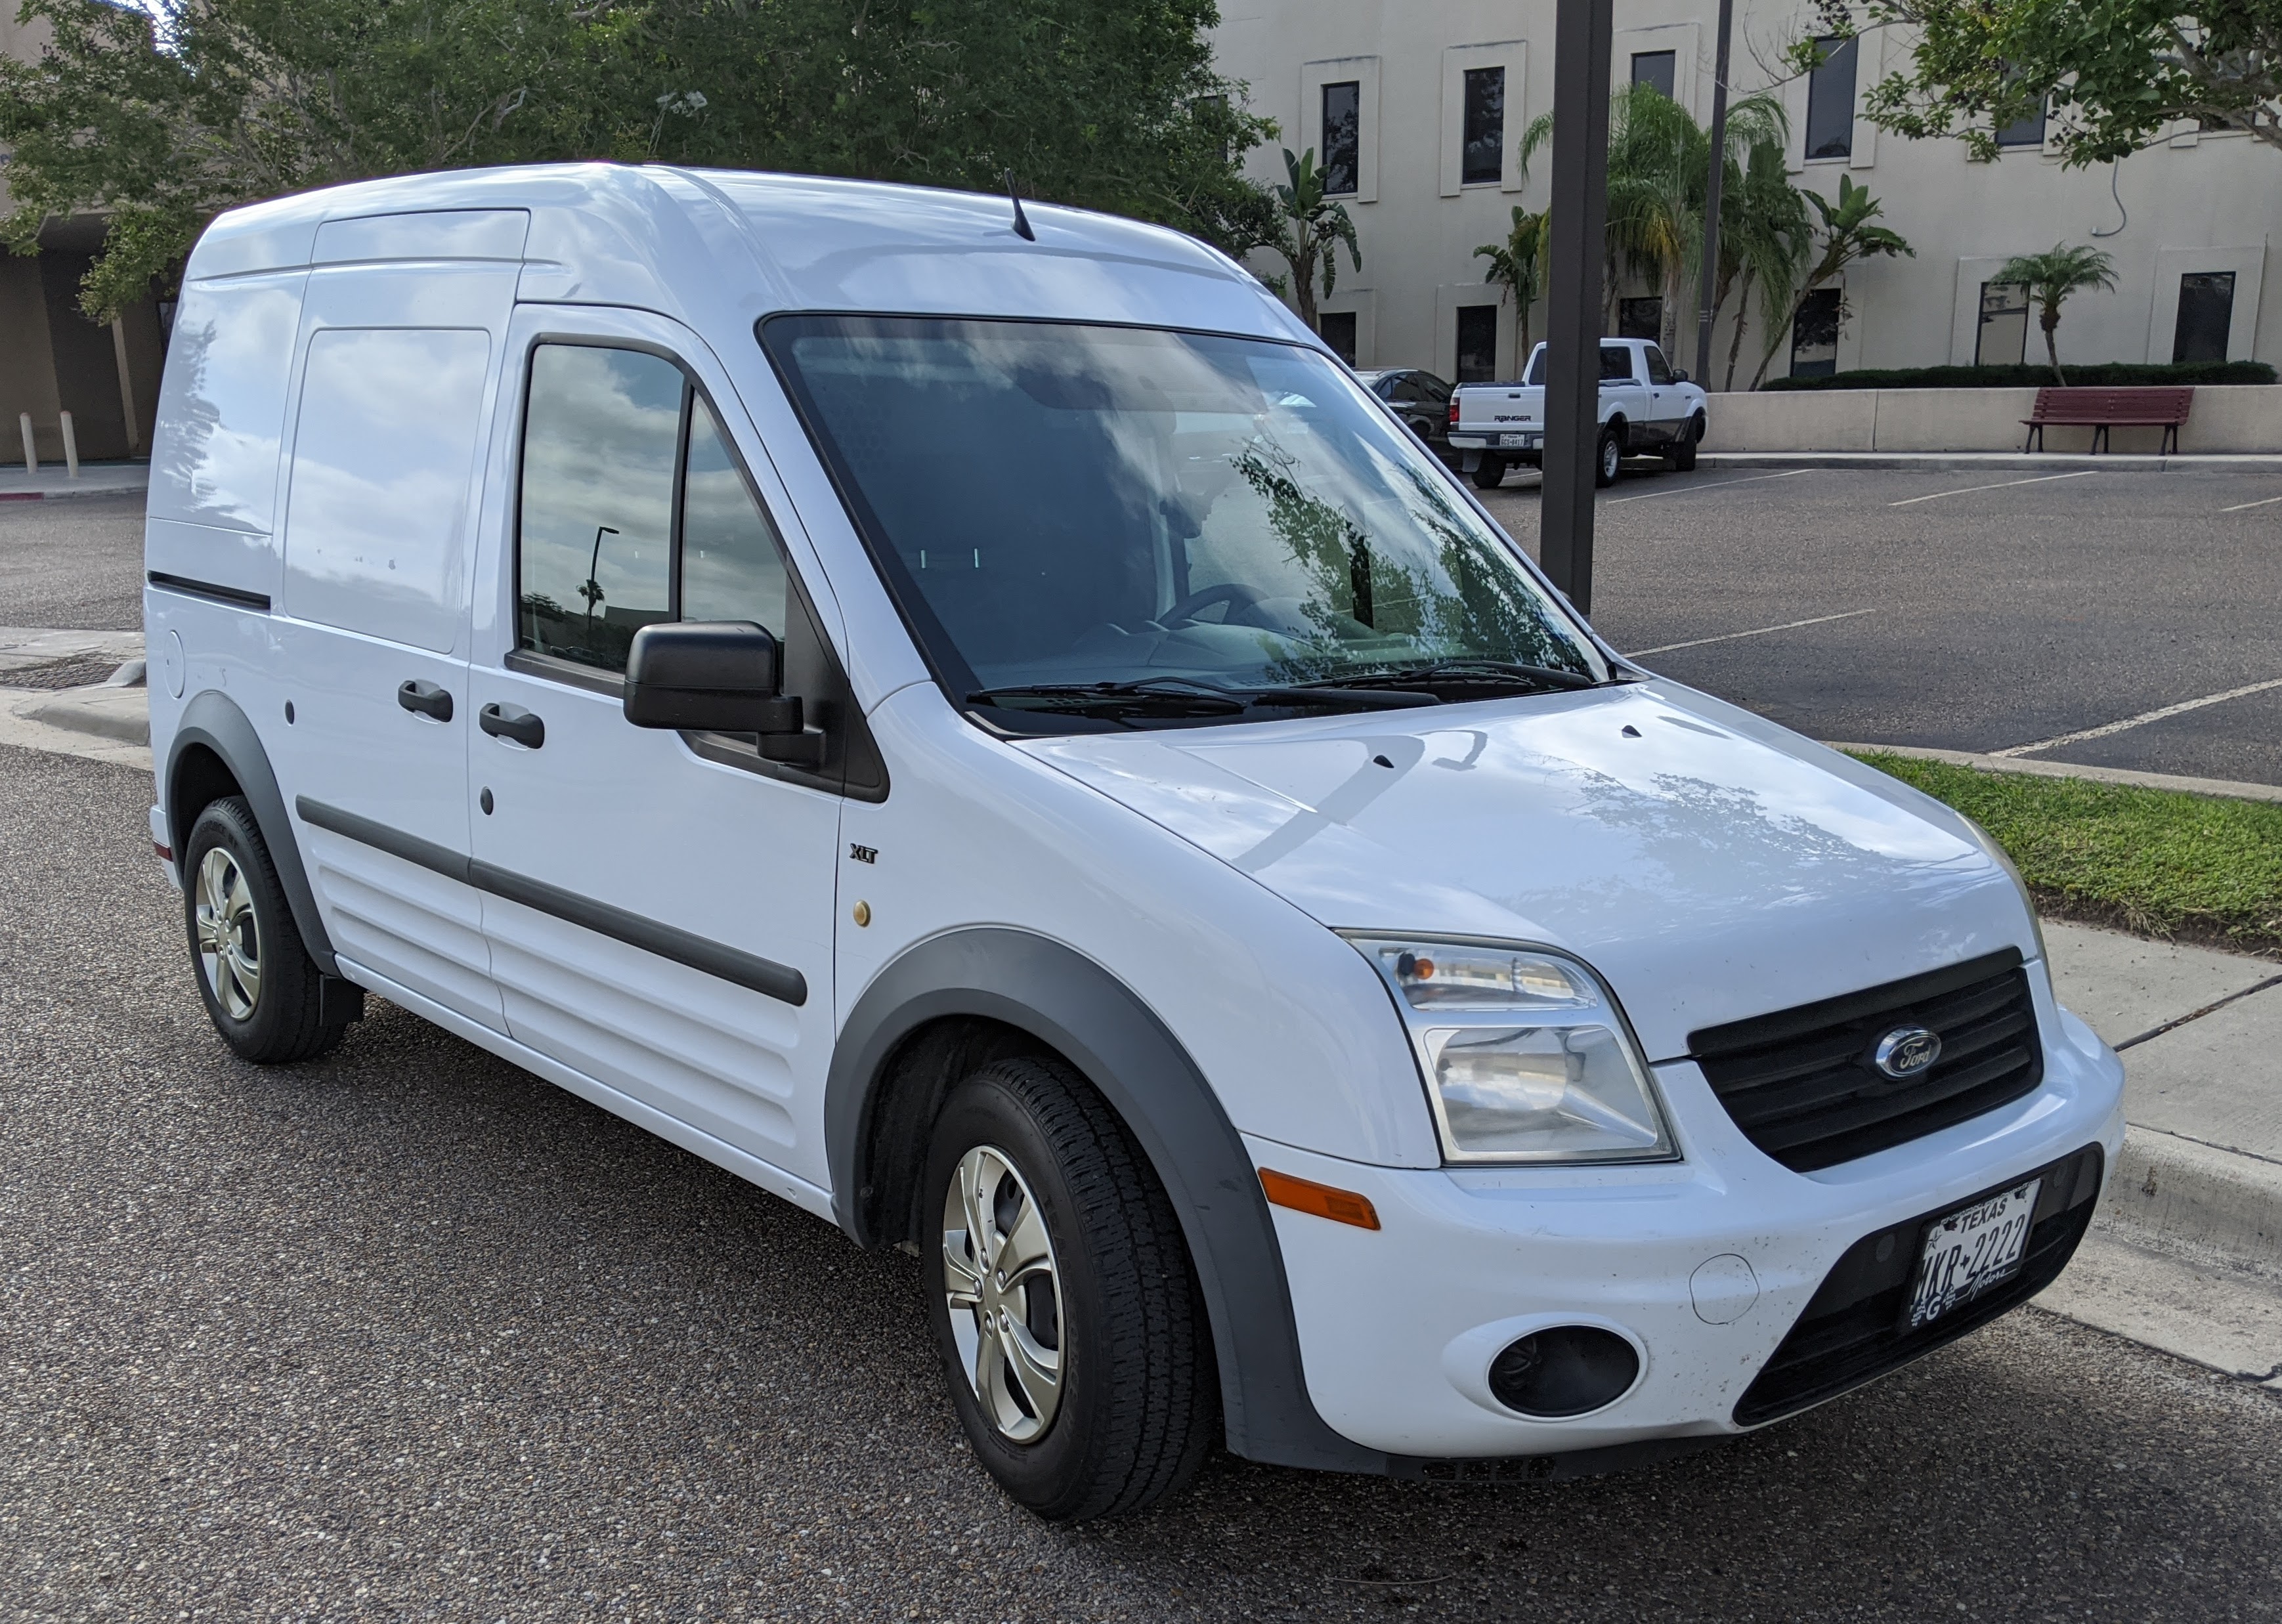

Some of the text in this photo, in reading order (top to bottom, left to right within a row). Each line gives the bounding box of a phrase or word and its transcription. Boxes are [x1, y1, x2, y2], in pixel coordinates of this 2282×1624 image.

[850, 843, 878, 864] XLT
[1900, 1041, 1931, 1069] Ford
[1960, 1198, 2007, 1233] TEXAS
